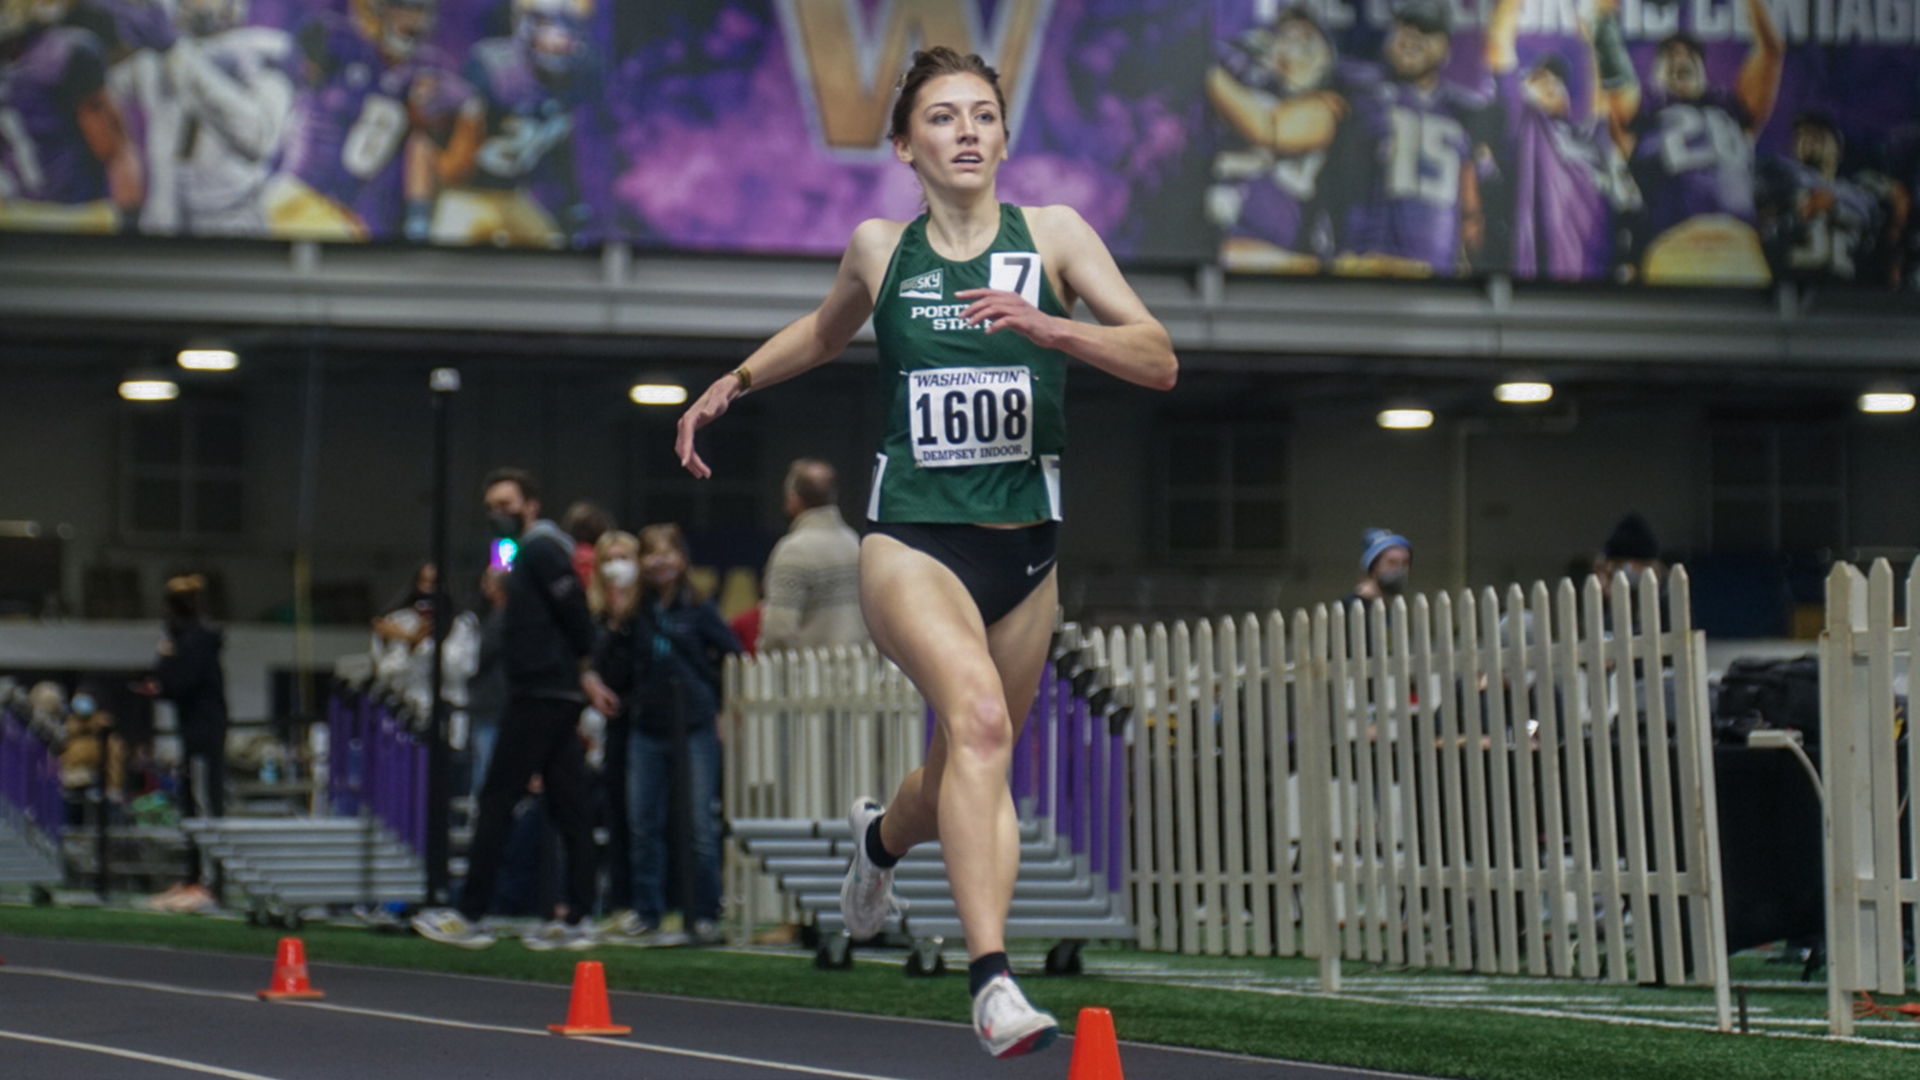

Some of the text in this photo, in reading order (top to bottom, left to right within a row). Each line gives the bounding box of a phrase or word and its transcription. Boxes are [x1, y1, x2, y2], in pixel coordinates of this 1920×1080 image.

[1388, 105, 1463, 203] 15
[1003, 257, 1031, 295] 7
[911, 304, 970, 319] PORT
[933, 318, 994, 330] STAE
[915, 370, 1022, 388] WASHINGTON
[916, 388, 1027, 445] 1608
[922, 444, 1023, 461] DEMPSEY INDOOR
